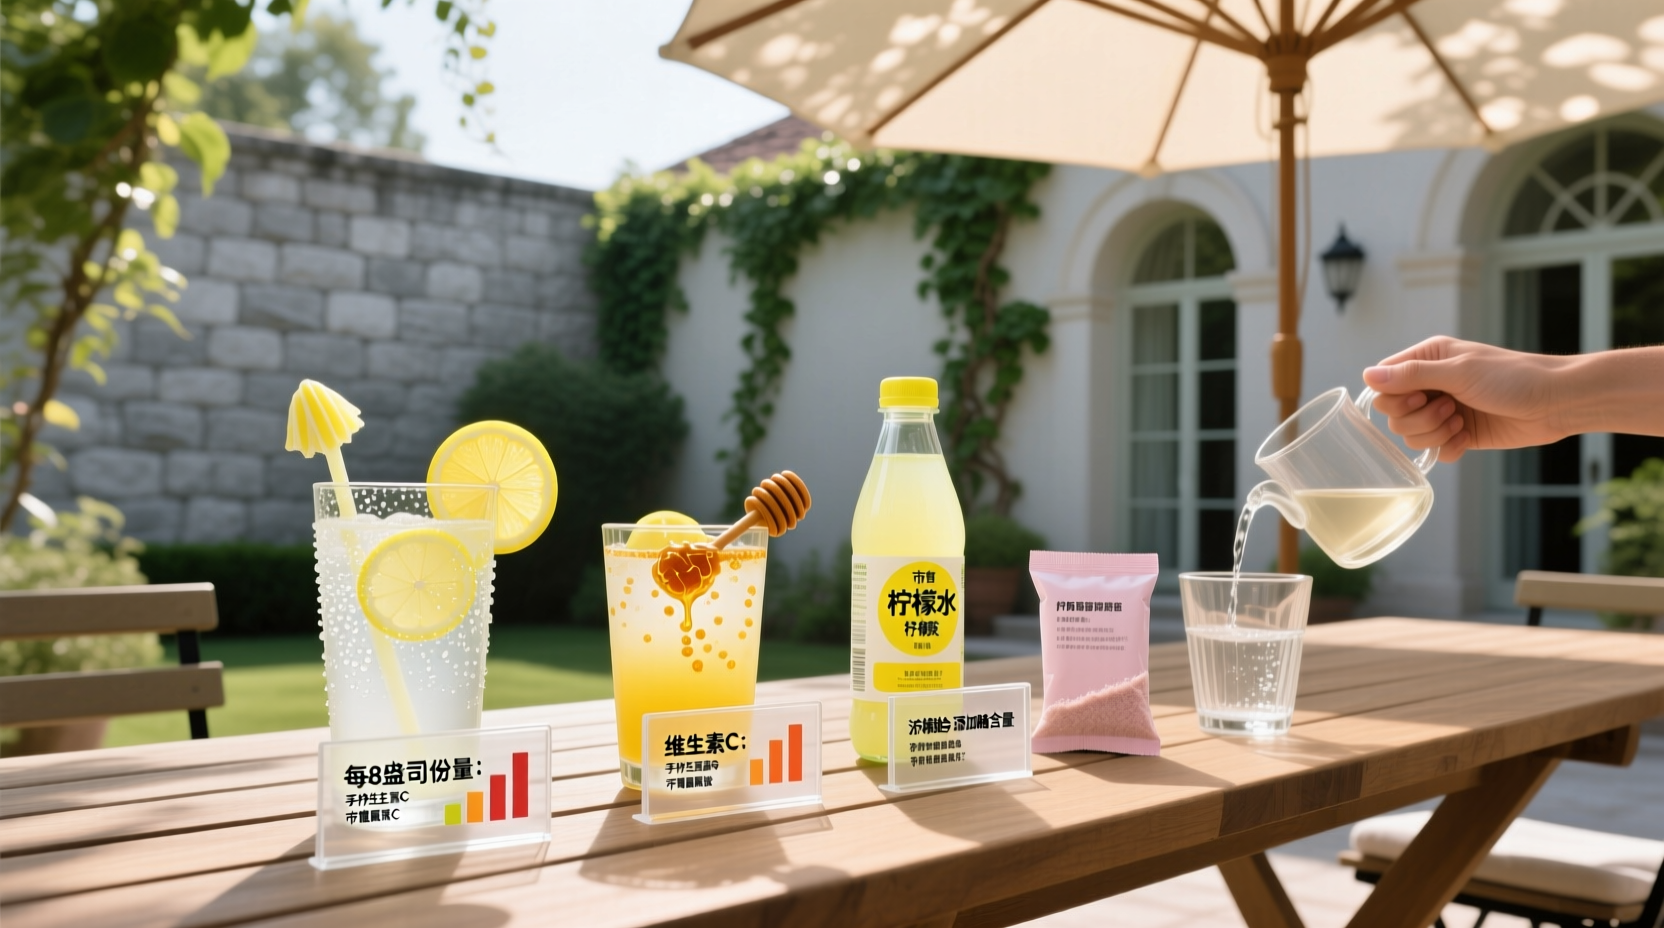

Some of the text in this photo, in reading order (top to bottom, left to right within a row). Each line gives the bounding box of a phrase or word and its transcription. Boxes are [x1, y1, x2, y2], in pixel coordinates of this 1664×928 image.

[888, 588, 956, 617] 柠檬水
[664, 732, 746, 757] 维生素C:
